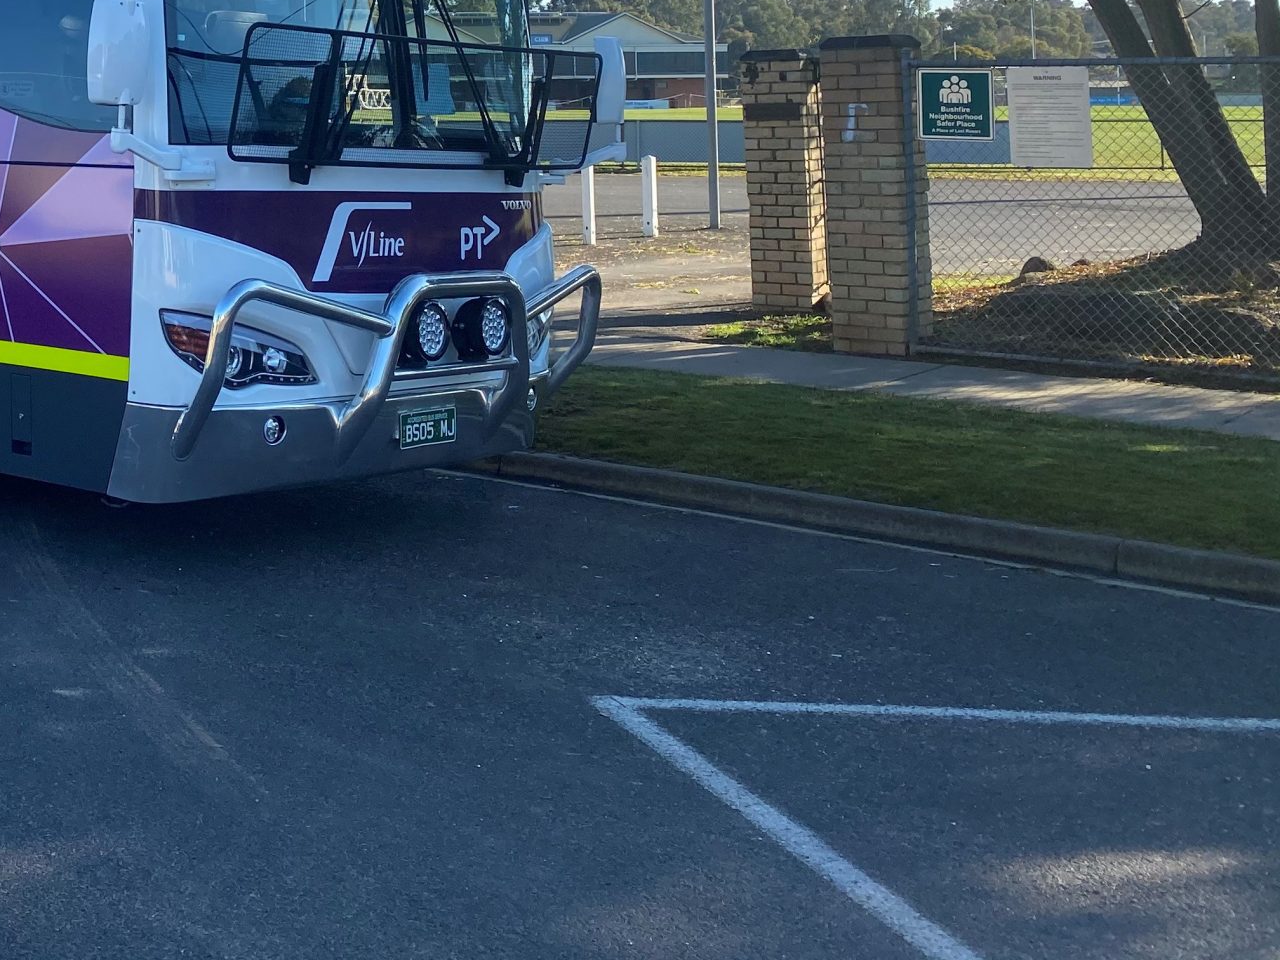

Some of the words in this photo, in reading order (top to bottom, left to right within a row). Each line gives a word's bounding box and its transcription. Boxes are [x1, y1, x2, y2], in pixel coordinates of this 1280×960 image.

[940, 105, 971, 113] Bushfire
[928, 113, 983, 121] Neighbourhood
[501, 200, 532, 210] VOLVO
[460, 226, 486, 260] PT
[406, 422, 434, 442] BS05
[440, 418, 455, 438] MJ
